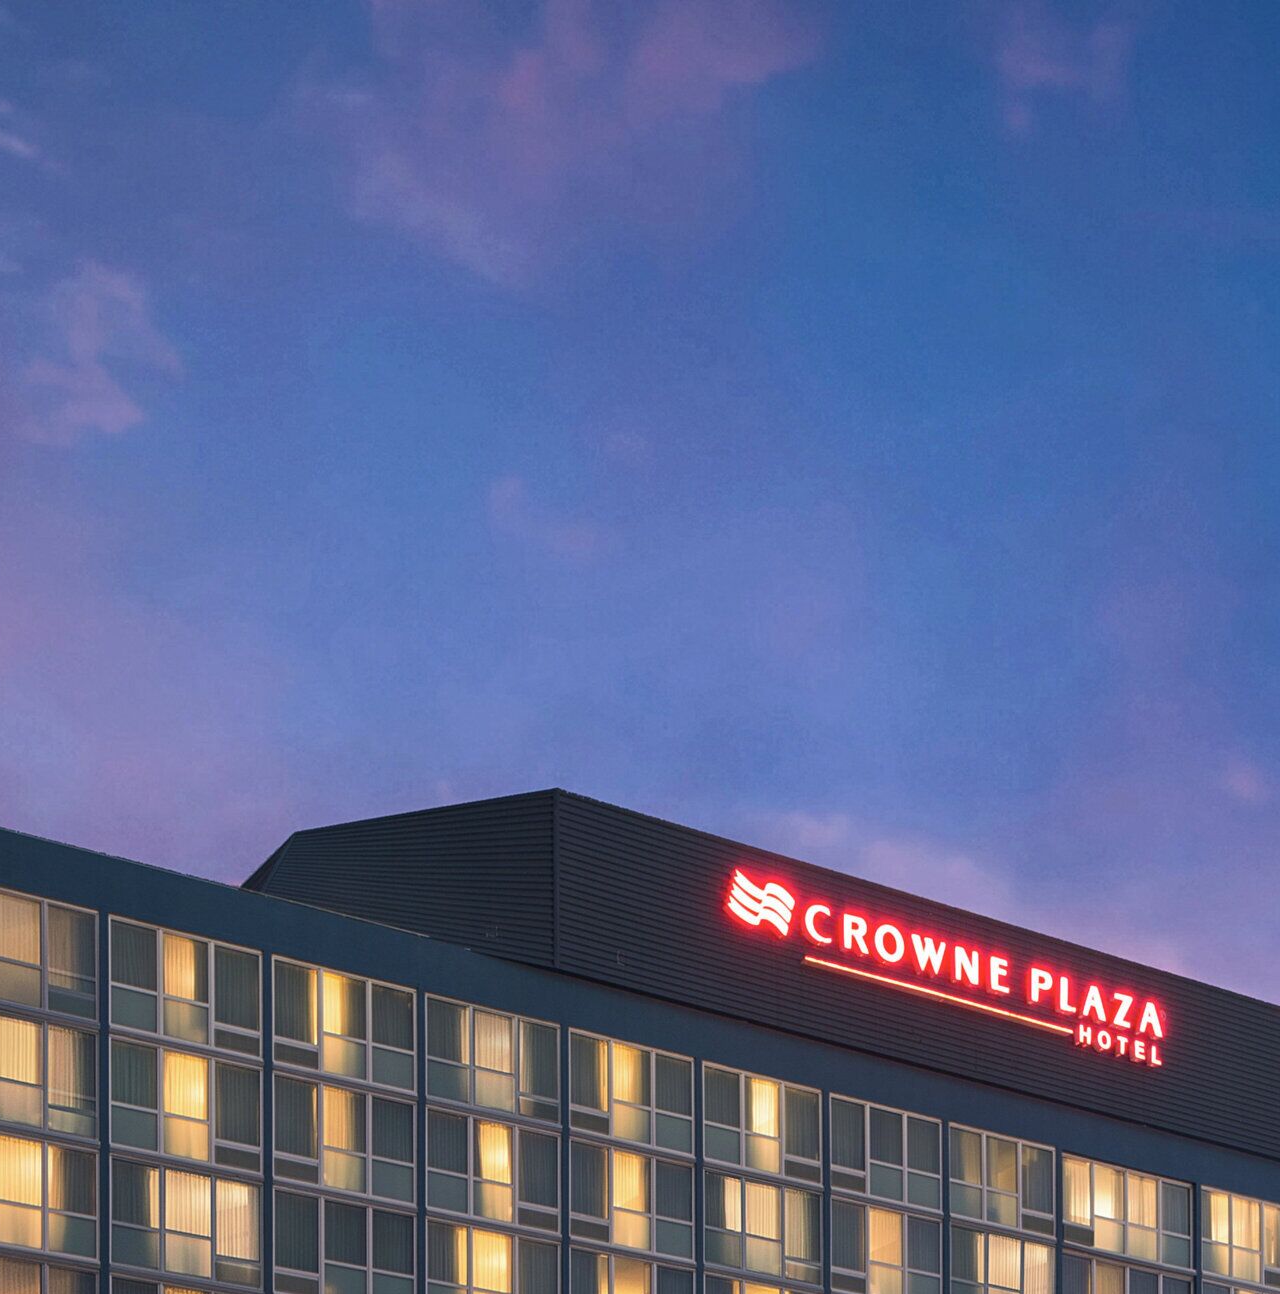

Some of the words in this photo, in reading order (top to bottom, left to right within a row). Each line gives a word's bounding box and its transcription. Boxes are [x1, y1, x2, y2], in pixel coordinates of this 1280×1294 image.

[804, 903, 1010, 994] CROWNE
[1031, 967, 1164, 1039] PLAZA
[1078, 1024, 1162, 1067] HOTEL
